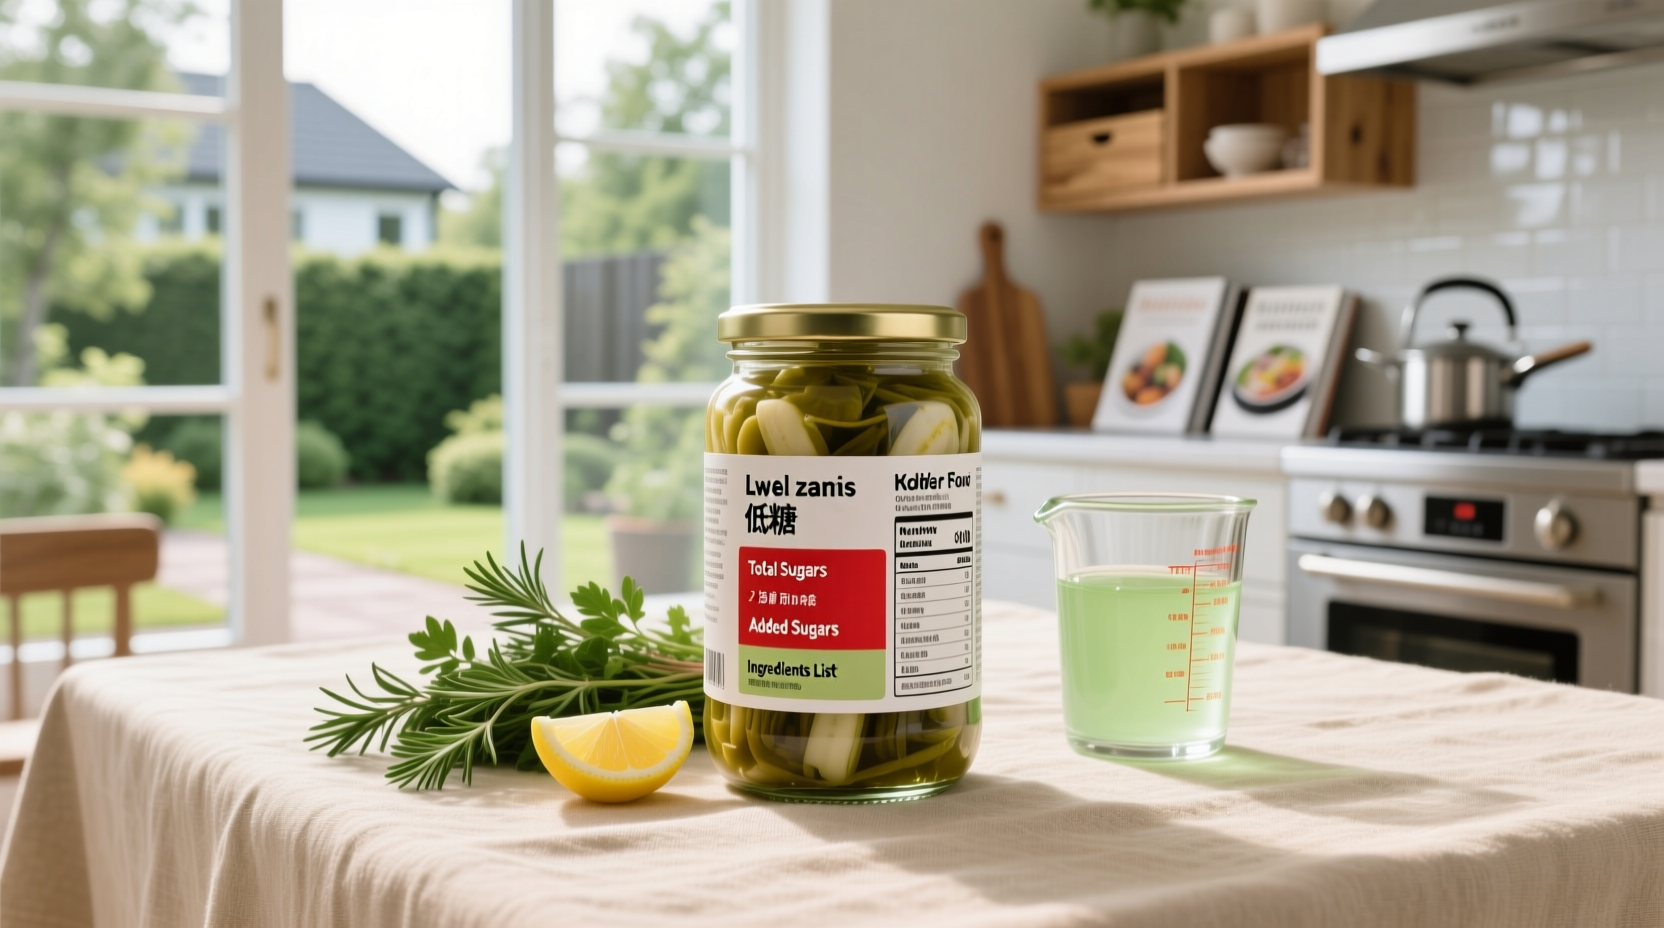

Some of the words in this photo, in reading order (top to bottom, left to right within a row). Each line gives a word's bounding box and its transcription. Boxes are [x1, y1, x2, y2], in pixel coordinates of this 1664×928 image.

[745, 474, 790, 497] Lwel
[795, 475, 857, 498] zanis
[745, 502, 798, 536] 低糖
[748, 560, 777, 577] Total
[780, 561, 828, 581] Sugars
[749, 617, 788, 635] Added
[791, 620, 840, 640] Sugars
[813, 663, 839, 678] List
